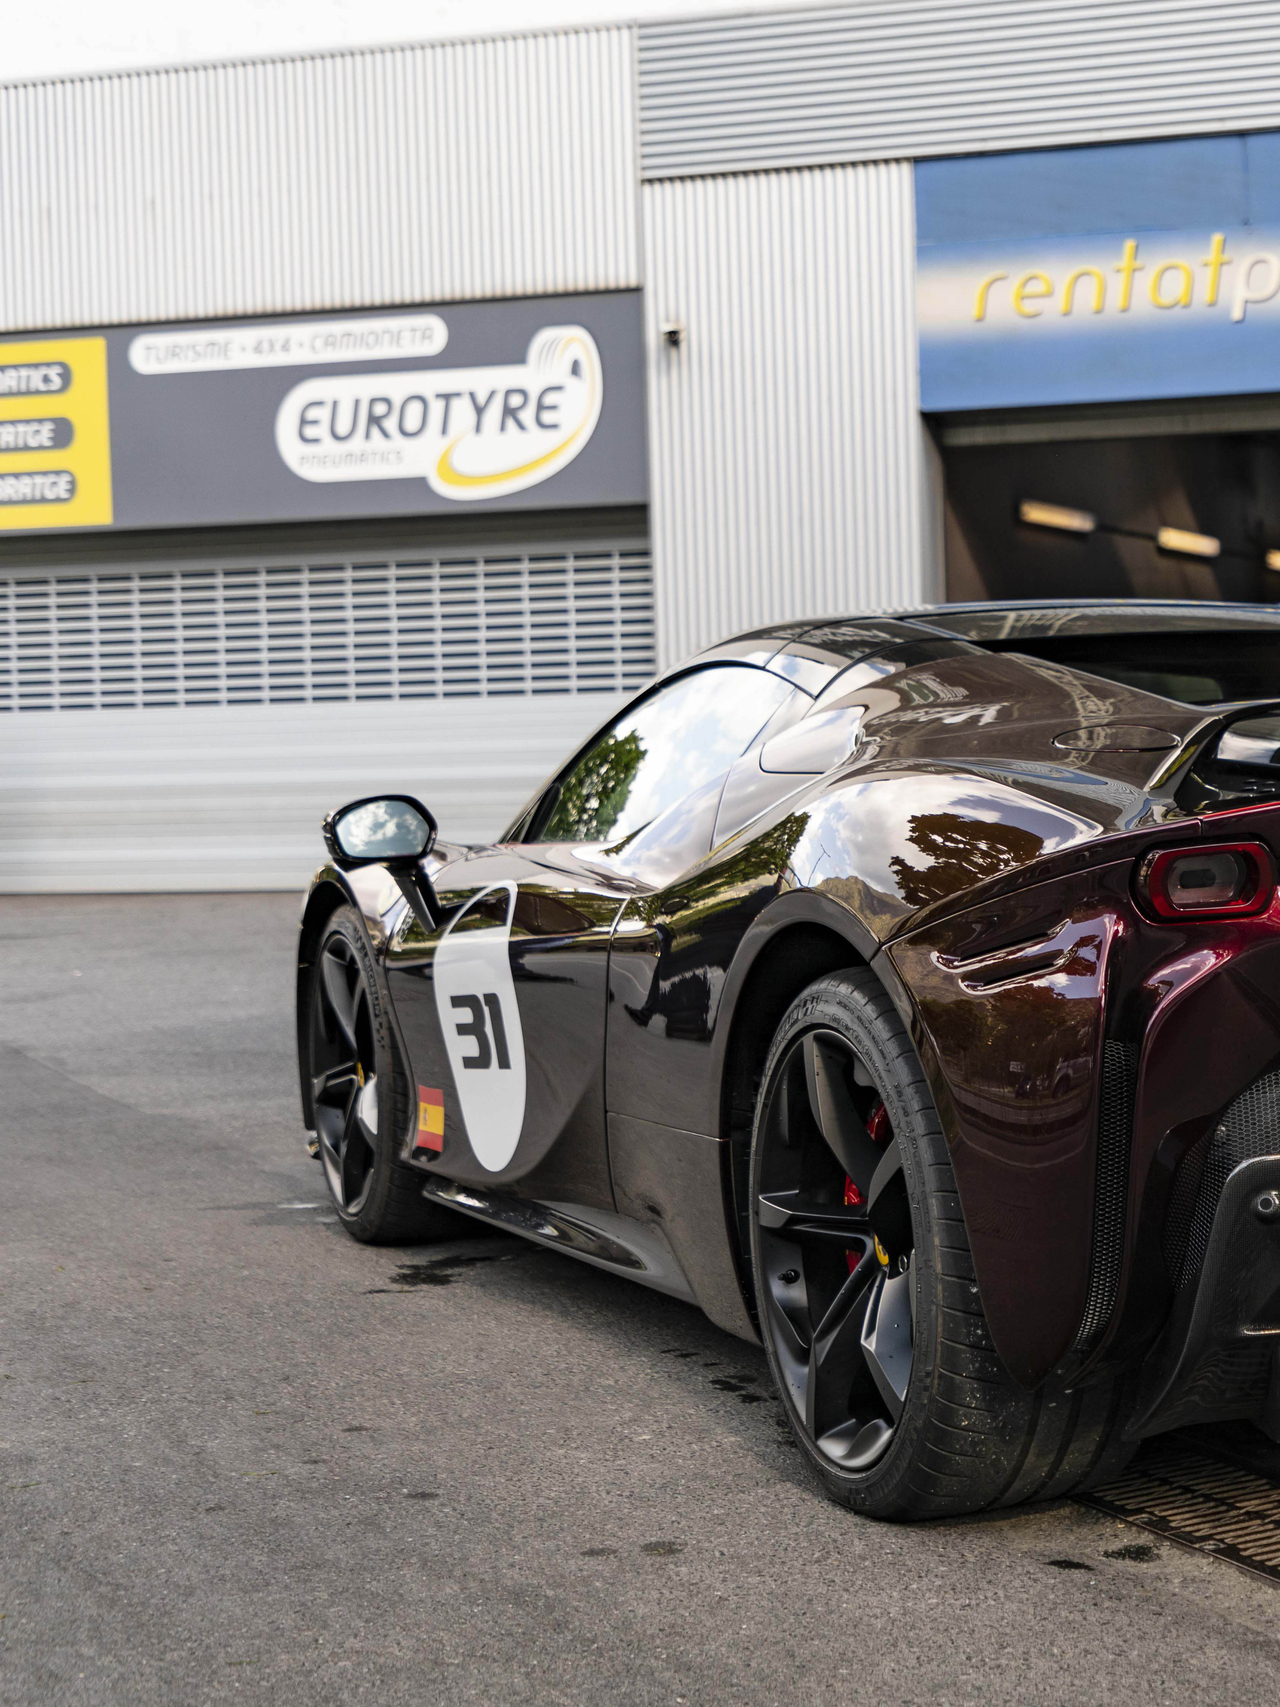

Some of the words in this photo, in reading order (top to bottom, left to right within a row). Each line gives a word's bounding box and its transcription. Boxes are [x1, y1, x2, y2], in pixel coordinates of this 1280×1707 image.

[144, 341, 233, 366] TURISME
[252, 335, 292, 357] 4X4
[310, 325, 436, 355] CAMIONETA
[0, 364, 64, 394] ATICS
[297, 384, 565, 444] EUROTYRE
[0, 420, 56, 450] ATGE
[0, 472, 73, 502] RATGE
[450, 992, 512, 1070] 31
